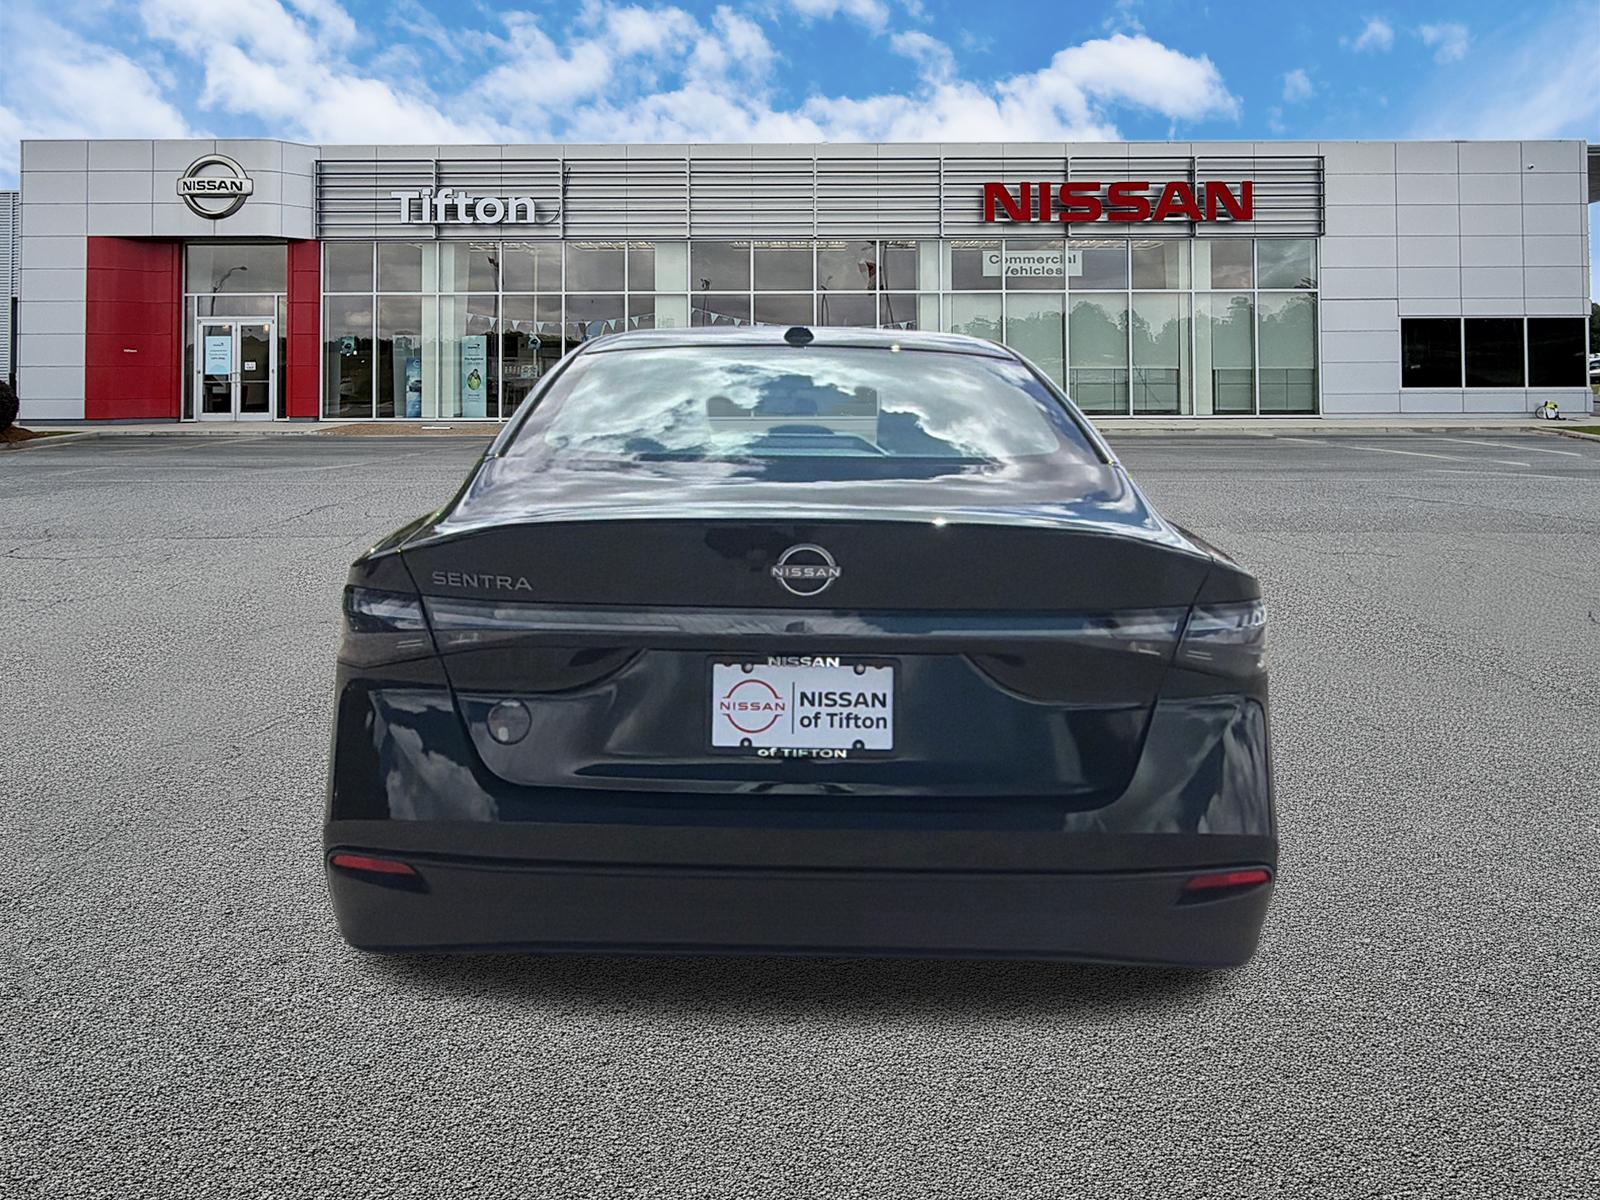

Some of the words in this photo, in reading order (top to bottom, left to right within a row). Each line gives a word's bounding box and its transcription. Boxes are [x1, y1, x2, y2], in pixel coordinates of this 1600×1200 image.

[182, 180, 243, 191] NISSAN
[390, 187, 536, 224] Tifton
[983, 181, 1254, 222] NISSAN
[772, 567, 841, 577] NISSAN
[431, 571, 533, 591] SENTRA
[767, 656, 840, 668] NISSAN
[719, 701, 785, 711] NISSAN
[800, 691, 887, 708] NISSAN
[799, 712, 821, 729] of
[826, 712, 888, 730] Tifton
[757, 747, 777, 758] of
[779, 748, 848, 759] TIFTON
